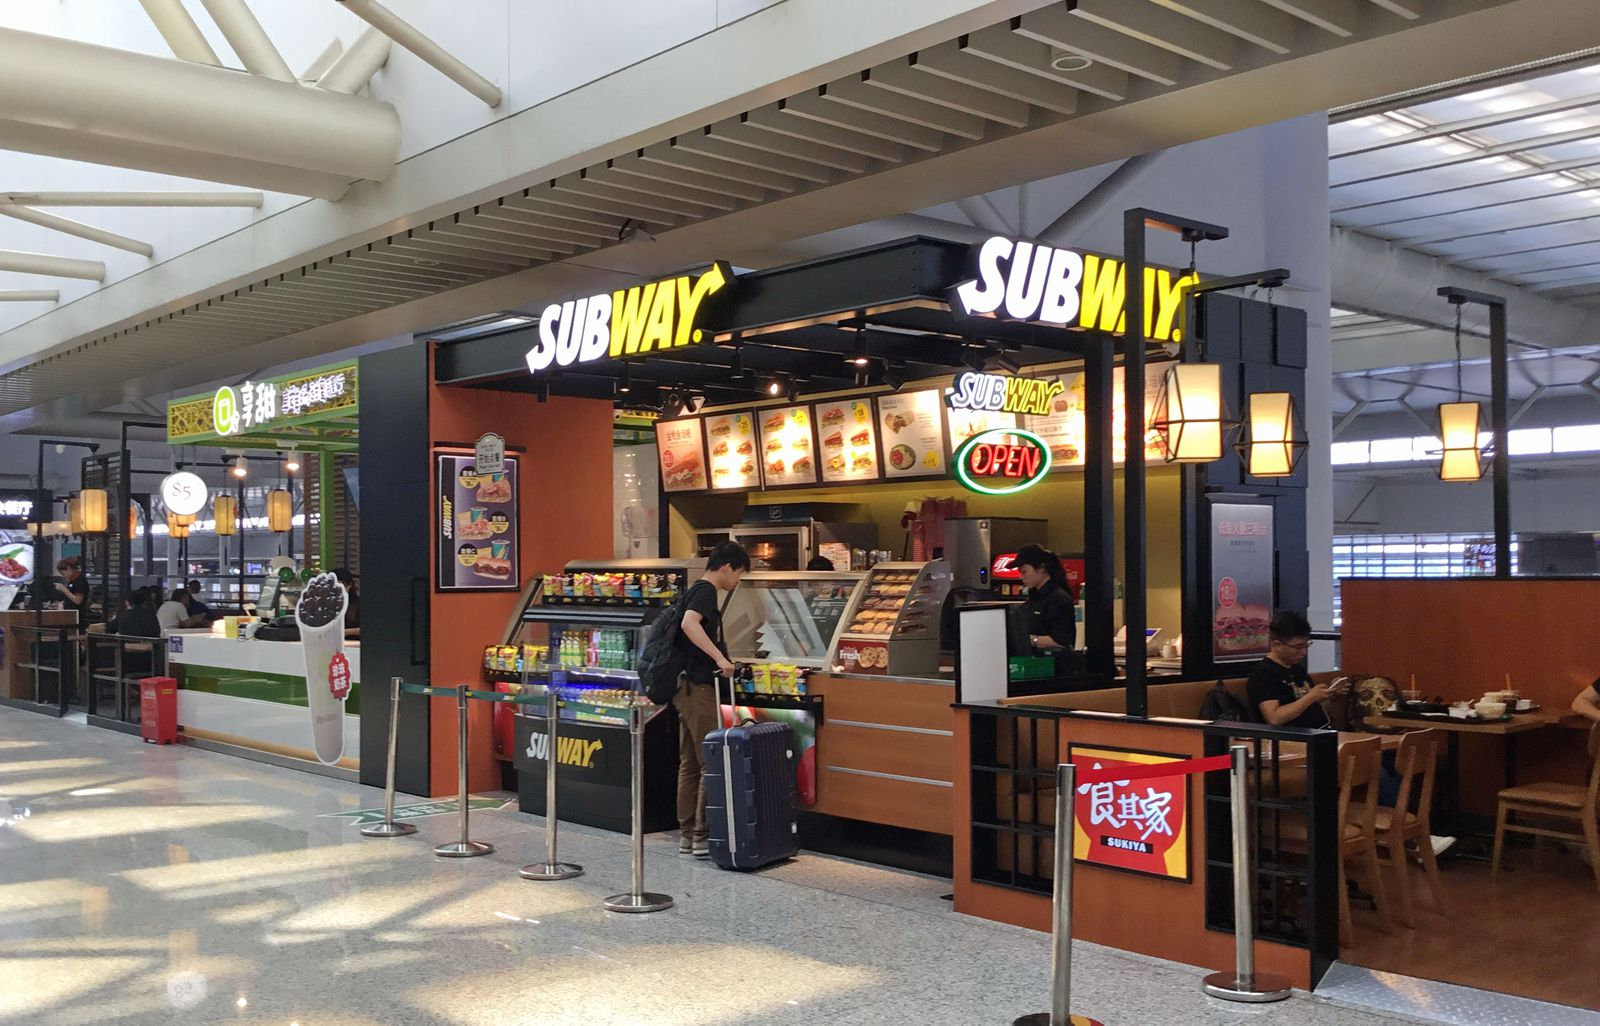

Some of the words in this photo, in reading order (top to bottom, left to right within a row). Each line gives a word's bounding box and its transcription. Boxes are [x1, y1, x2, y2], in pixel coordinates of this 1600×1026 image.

[525, 262, 726, 374] SUBWAY
[240, 381, 276, 427] 享甜
[950, 371, 1064, 416] SUBWAY
[970, 443, 1041, 478] OPEN
[442, 495, 453, 539] SUBWAY
[839, 649, 860, 660] Fresh
[526, 731, 603, 767] SUWAY
[1107, 837, 1147, 852] SUKIYA
